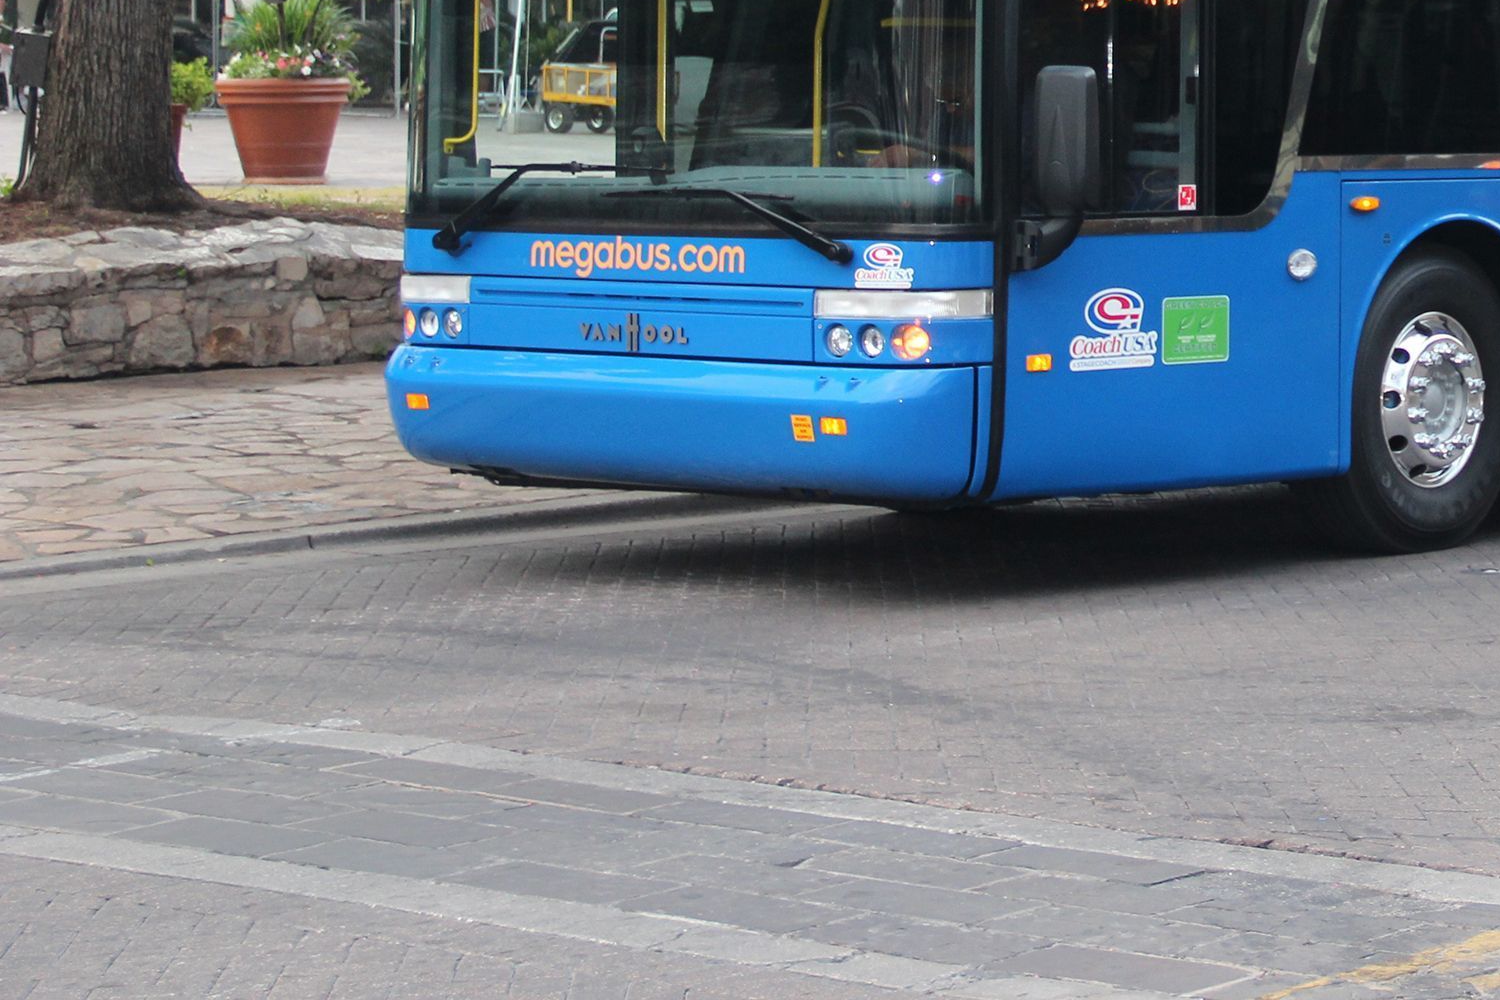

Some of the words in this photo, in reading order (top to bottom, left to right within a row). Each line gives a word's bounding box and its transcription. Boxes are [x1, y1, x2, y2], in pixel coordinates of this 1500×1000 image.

[530, 235, 745, 278] megabus.com
[579, 321, 622, 342] VAN
[626, 312, 689, 351] HOOL
[1072, 334, 1121, 356] Coach
[1123, 333, 1155, 354] USA
